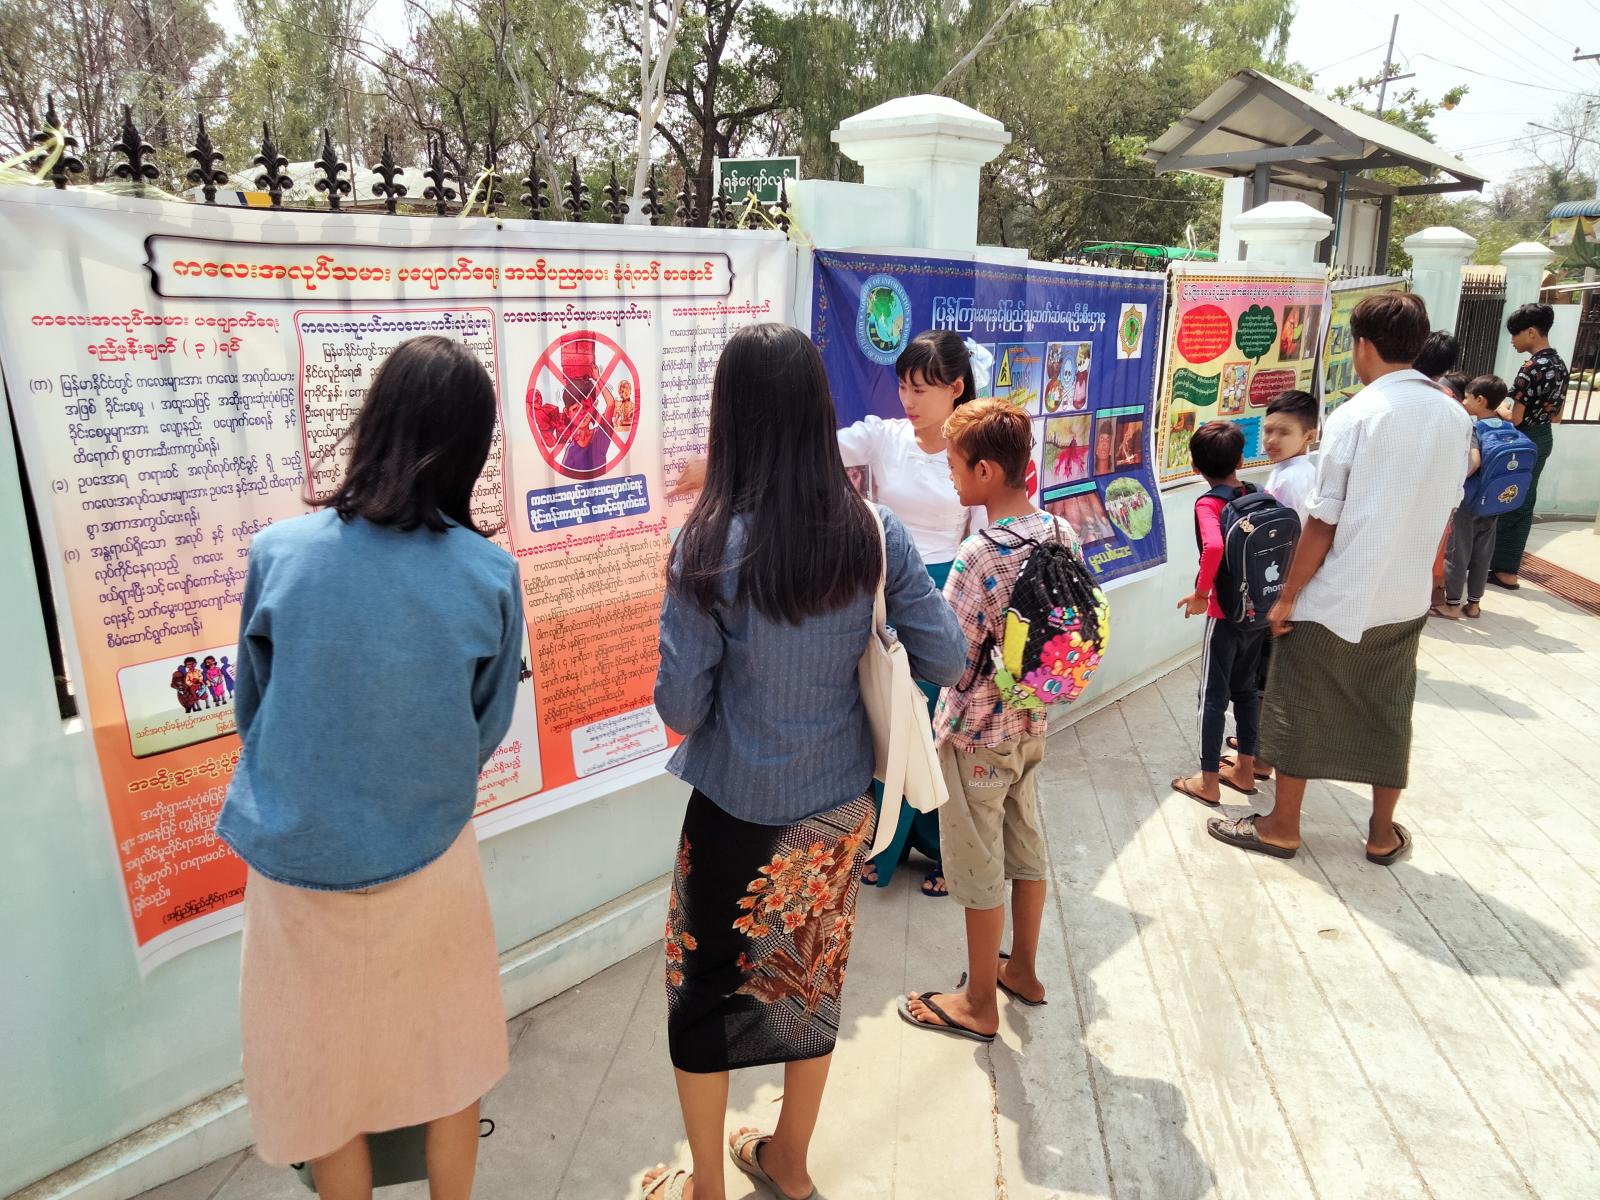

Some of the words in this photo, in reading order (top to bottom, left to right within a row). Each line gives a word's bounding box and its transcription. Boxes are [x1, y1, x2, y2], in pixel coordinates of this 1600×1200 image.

[172, 255, 391, 291] ကလေးအလုပ်သမား
[398, 257, 500, 292] ပပျောက်ရေး
[504, 258, 608, 289] အသိပညာပေး
[614, 260, 661, 289] နံရံကပ်
[664, 261, 714, 281] စာစောင်
[31, 309, 189, 334] ကလေးအလုပ်သမား
[194, 311, 280, 333] ပပျောက်ရေး
[88, 337, 177, 361] ရည်မှန်းချက်
[60, 372, 133, 398] မြန်မာနိုင်ငံတွင်
[206, 374, 238, 385] ကလေး
[242, 368, 295, 385] အလုပ်သမား
[1262, 582, 1287, 597] iPhon
